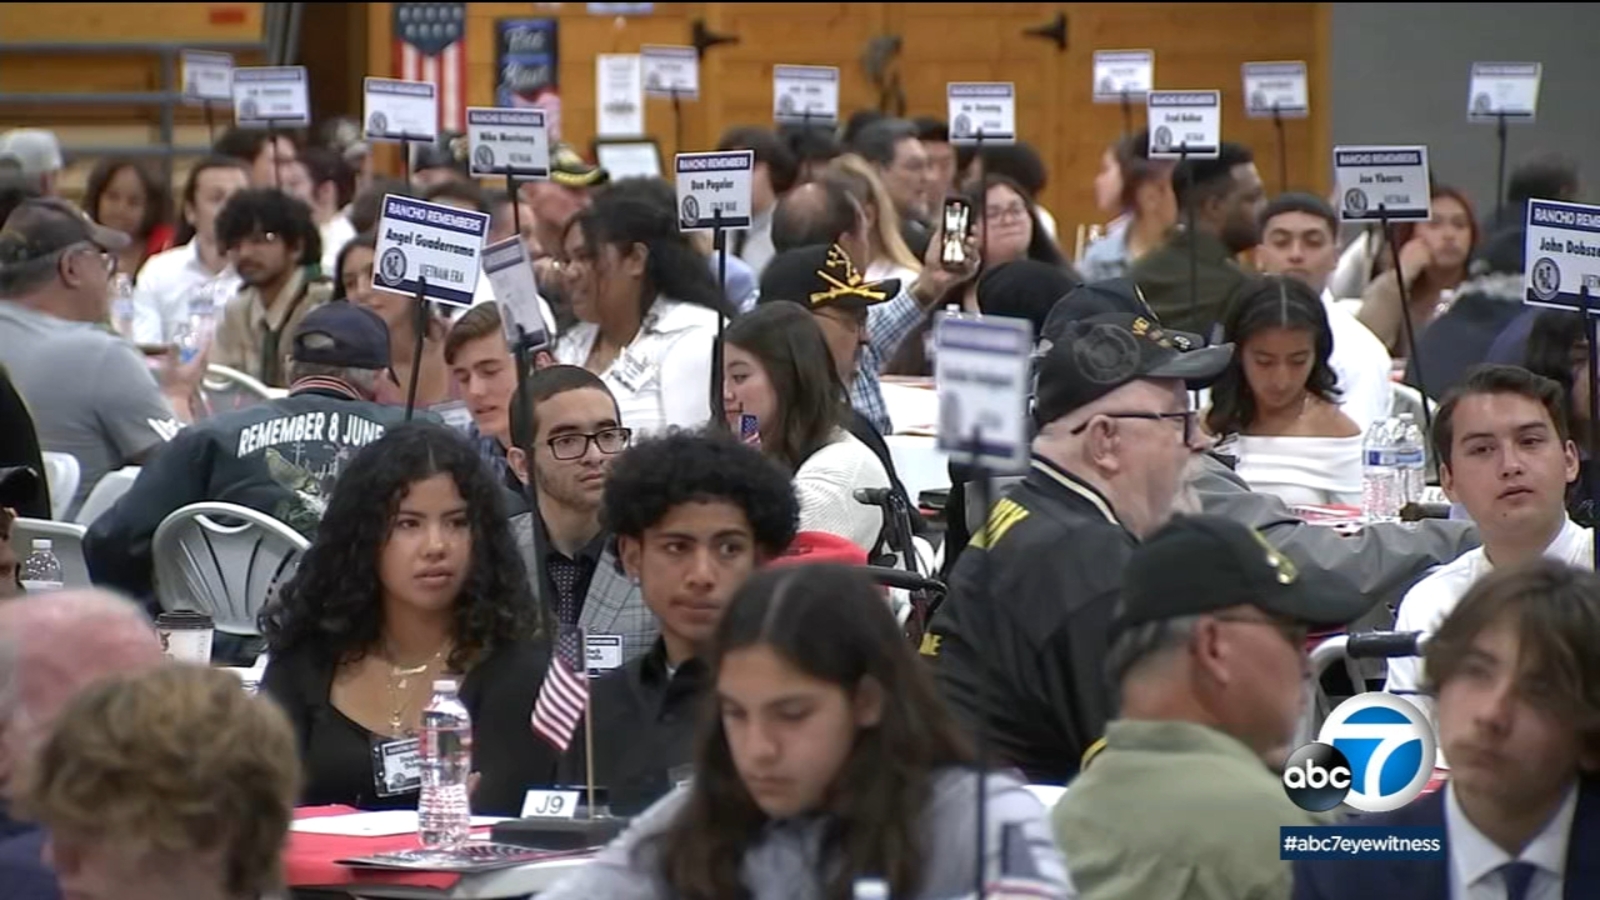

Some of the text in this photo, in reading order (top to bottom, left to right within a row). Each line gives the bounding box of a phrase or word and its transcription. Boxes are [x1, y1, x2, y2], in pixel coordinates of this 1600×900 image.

[387, 202, 482, 232] RANCHO REMEMBERS
[1534, 207, 1575, 225] RANCHO
[385, 228, 414, 246] Angel
[415, 234, 475, 258] Guaderrama
[1540, 237, 1563, 253] John
[450, 269, 465, 284] ERA
[237, 412, 325, 459] REMEMBER
[328, 411, 340, 442] 8
[535, 795, 564, 815] J9
